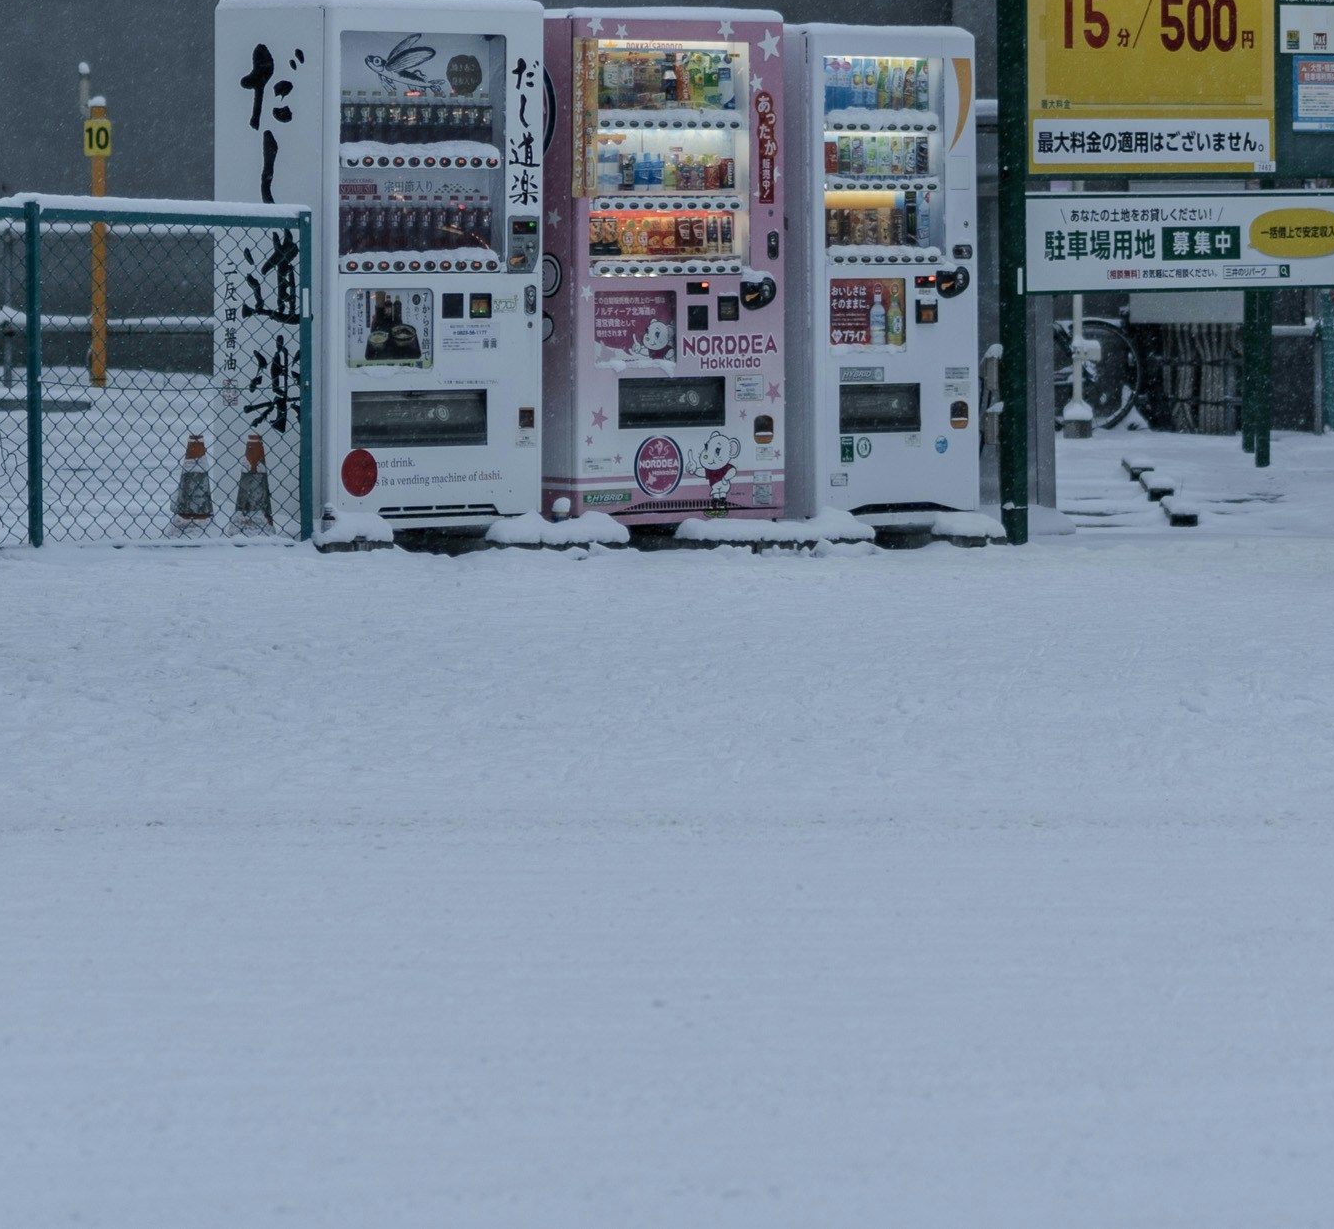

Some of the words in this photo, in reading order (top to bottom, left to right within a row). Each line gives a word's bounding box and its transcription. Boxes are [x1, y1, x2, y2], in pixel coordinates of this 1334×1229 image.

[1041, 100, 1071, 109] 最大料金
[85, 127, 110, 150] 10
[509, 58, 541, 206] だし道楽
[1037, 132, 1265, 153] 最大料金の適用はございません。
[1044, 230, 1156, 261] 駐車場用地
[1172, 230, 1232, 255] 募集中
[831, 286, 867, 296] おいしさは
[831, 299, 871, 309] そのままに。
[682, 334, 778, 356] NORDDEA
[700, 355, 762, 370] Hokkaido
[390, 458, 416, 468] drink.
[639, 459, 680, 469] NORDDEA
[397, 475, 430, 487] vending
[431, 473, 467, 484] machine
[468, 471, 478, 482] of
[478, 470, 503, 481] dashi.
